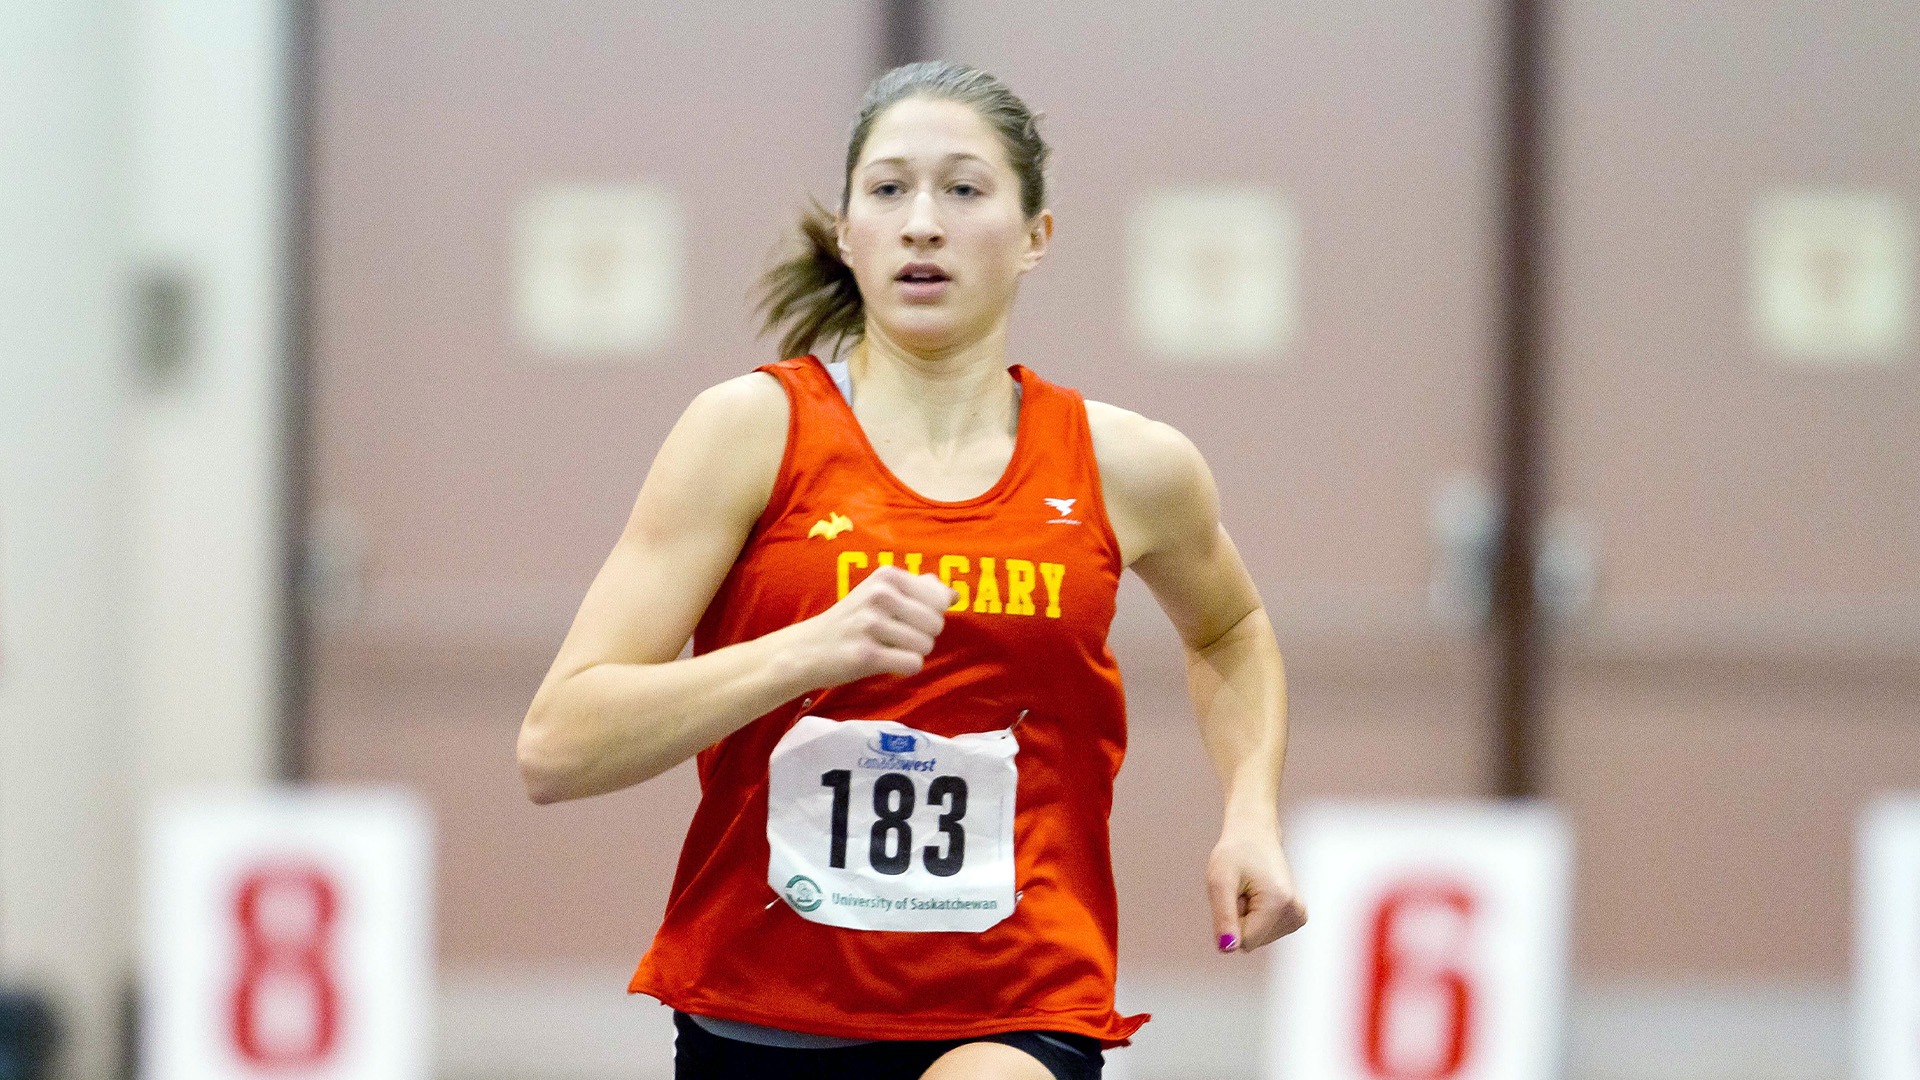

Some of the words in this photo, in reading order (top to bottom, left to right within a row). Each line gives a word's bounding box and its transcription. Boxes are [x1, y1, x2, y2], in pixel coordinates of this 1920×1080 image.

[836, 551, 1066, 619] CGARY
[821, 769, 968, 877] 183
[831, 892, 893, 911] University
[895, 897, 908, 910] of
[910, 897, 998, 910] Saskatchewan
[229, 861, 341, 1069] 8
[1358, 878, 1474, 1080] 6
